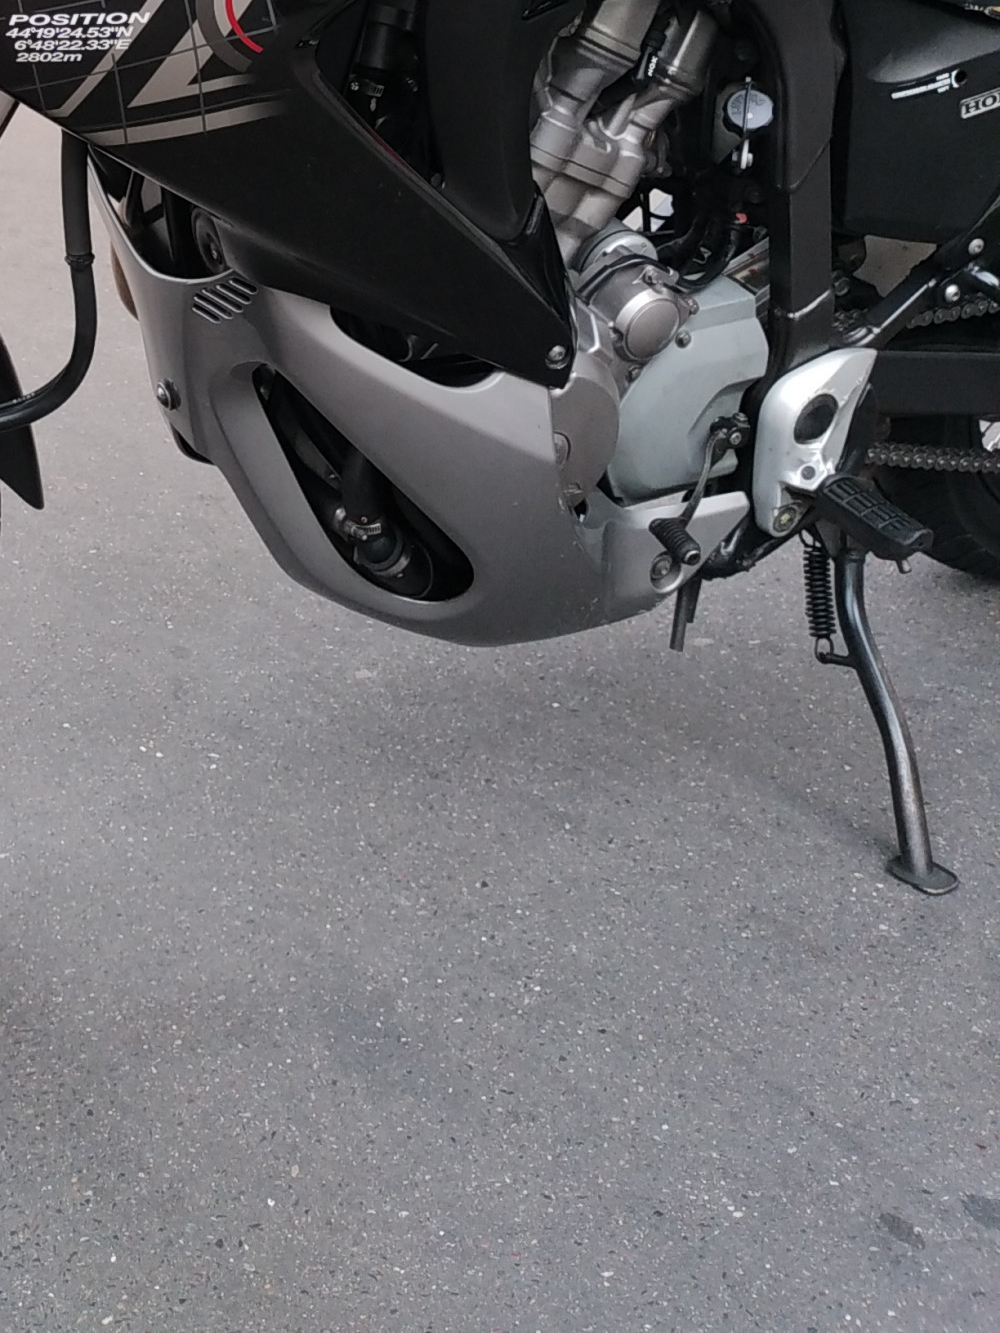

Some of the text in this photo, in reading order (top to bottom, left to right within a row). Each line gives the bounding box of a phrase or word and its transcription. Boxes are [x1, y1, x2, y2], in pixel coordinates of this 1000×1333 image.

[9, 12, 151, 26] POSITION
[16, 52, 83, 62] 2802m
[964, 92, 1000, 115] HO
